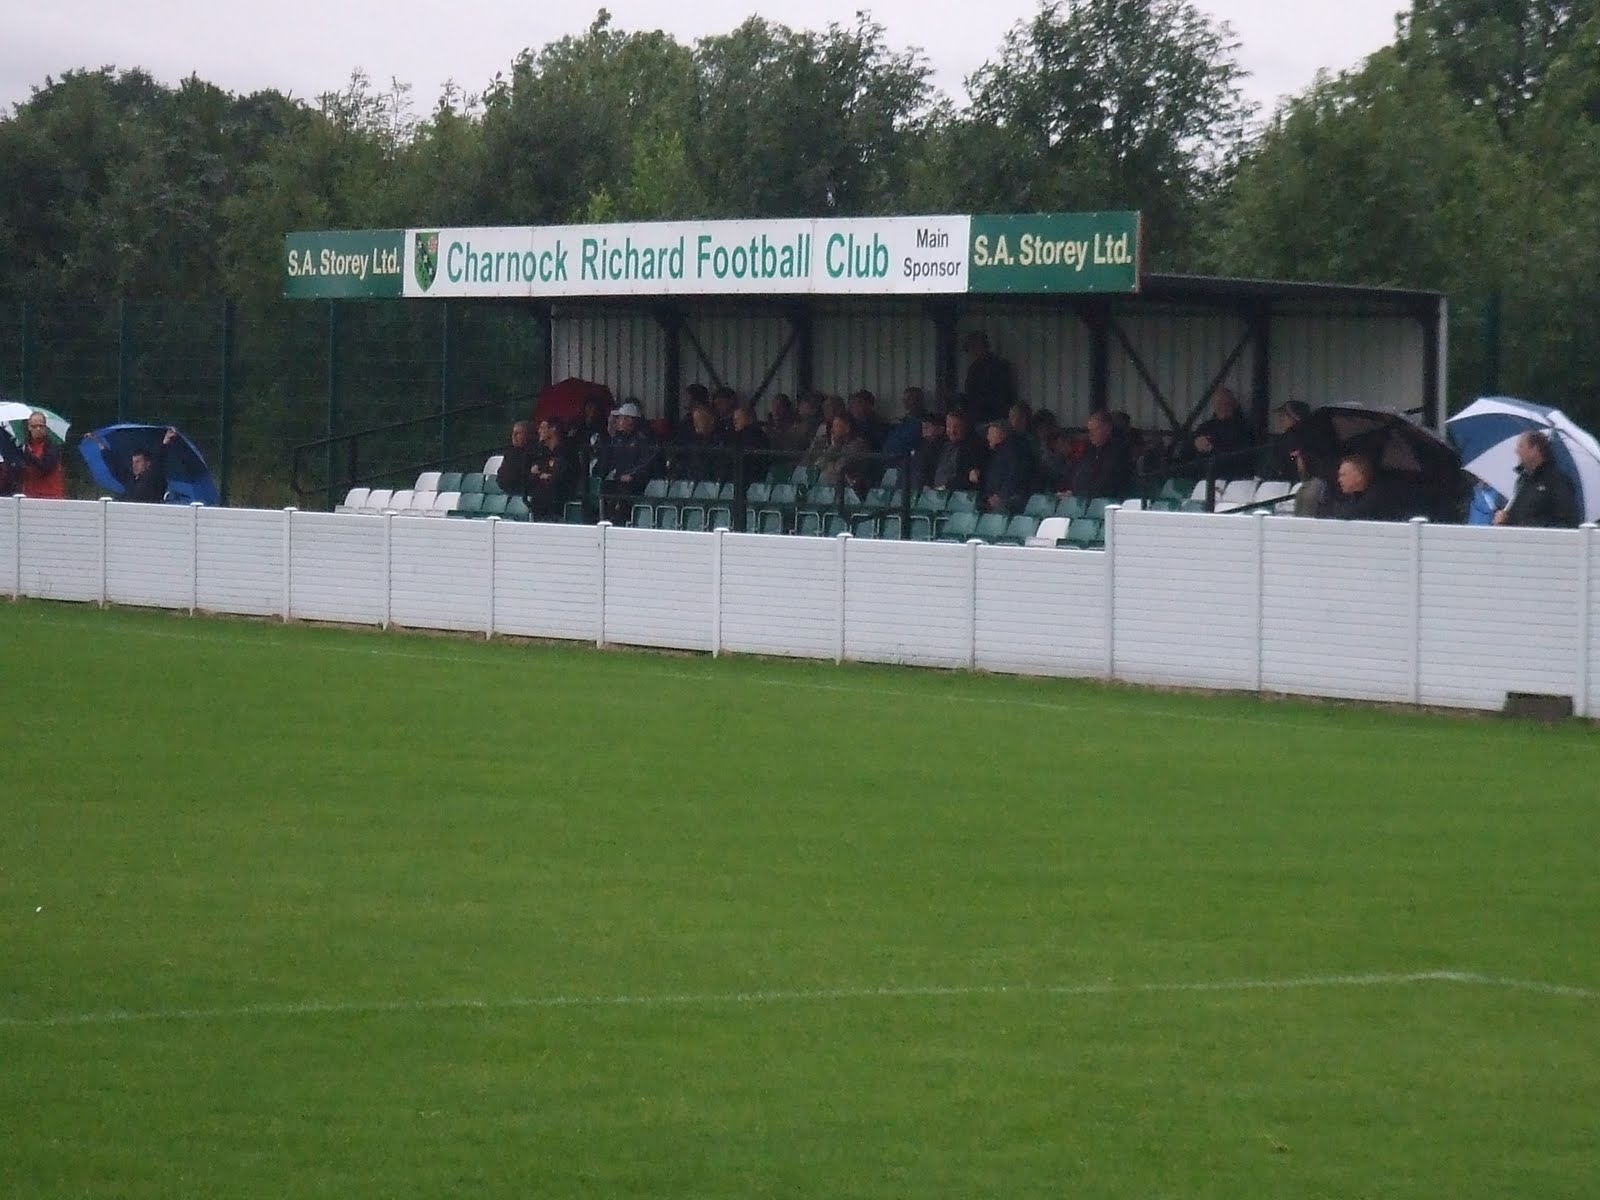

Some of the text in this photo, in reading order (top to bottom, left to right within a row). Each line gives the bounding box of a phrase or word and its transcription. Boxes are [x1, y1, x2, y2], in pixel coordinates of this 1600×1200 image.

[916, 228, 949, 248] Main
[974, 232, 1132, 271] S.A. Storey Ltd.
[287, 247, 401, 280] S.A. Storey Ltd.
[447, 232, 889, 283] Charnock Richard Football Club
[903, 258, 961, 281] Sponsor
